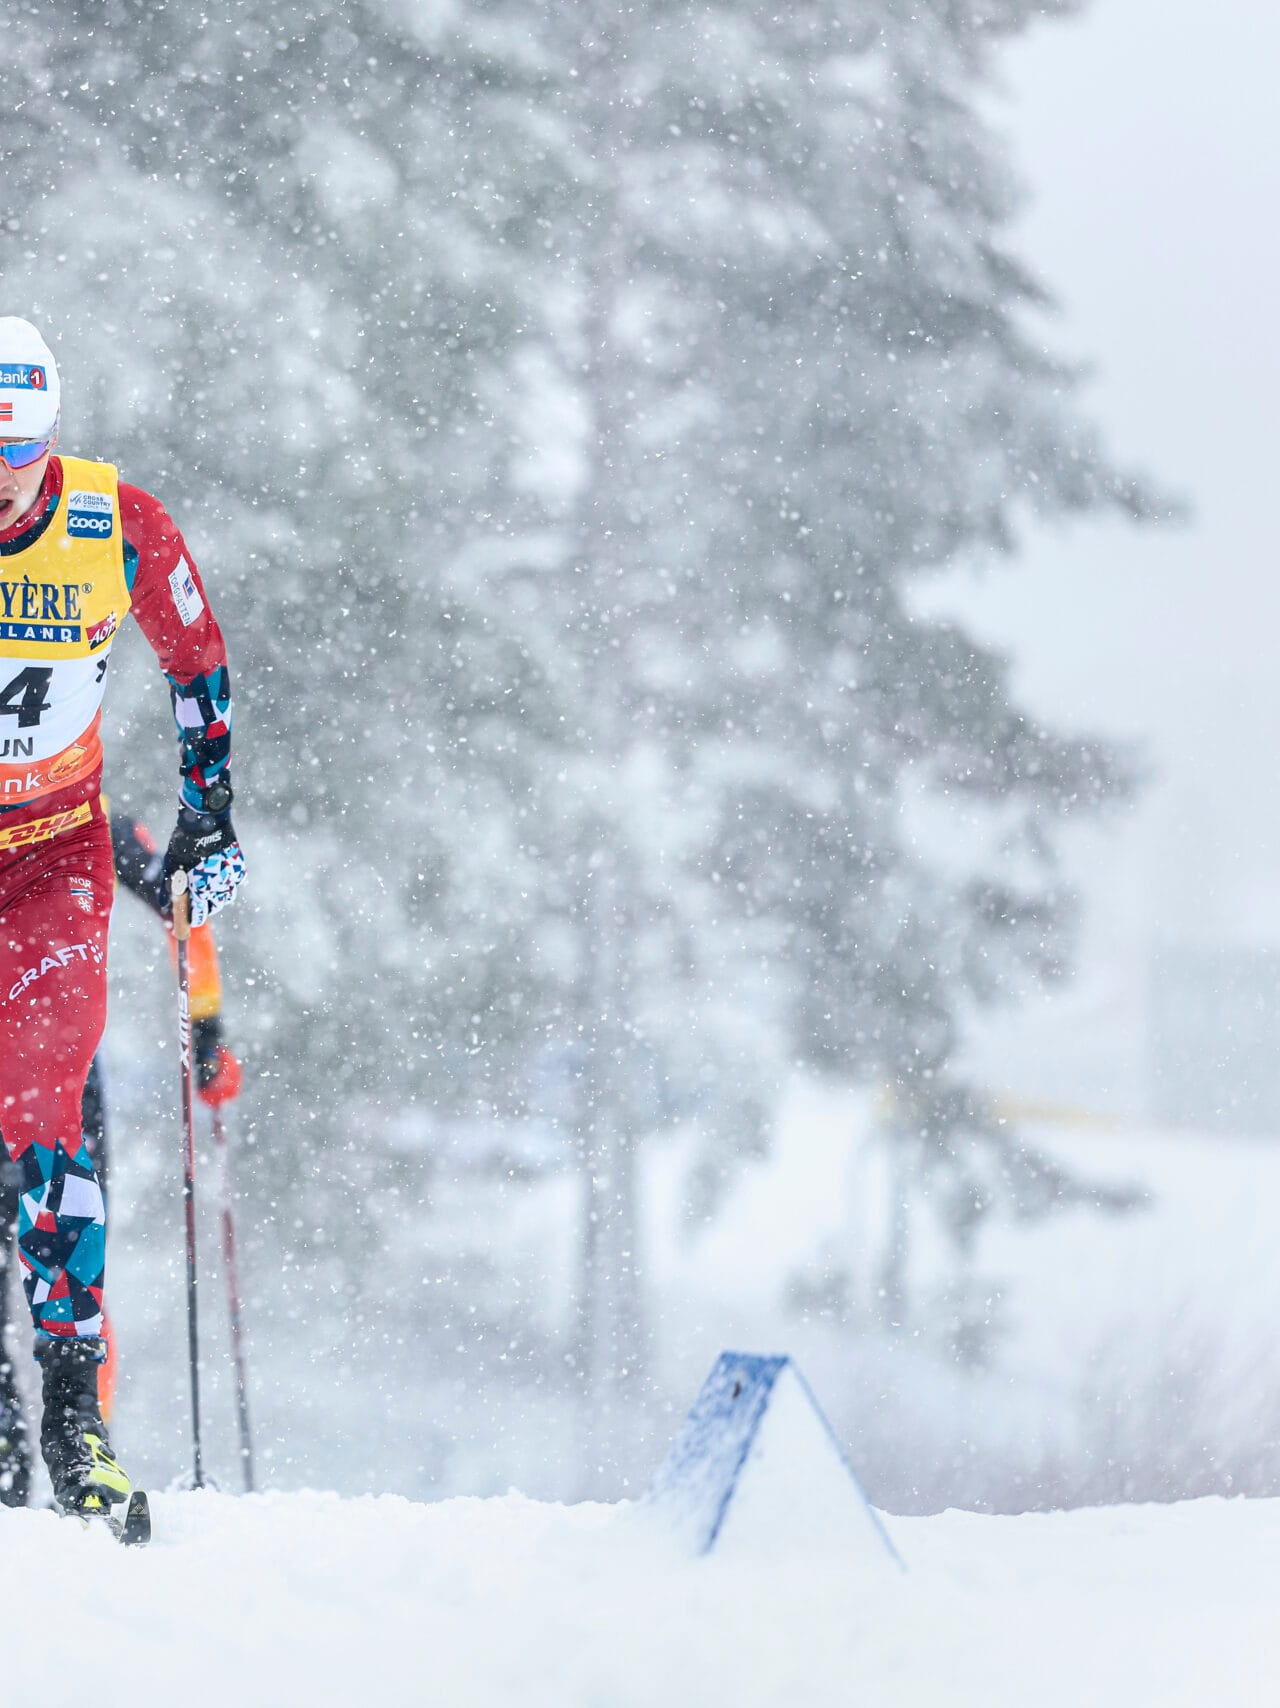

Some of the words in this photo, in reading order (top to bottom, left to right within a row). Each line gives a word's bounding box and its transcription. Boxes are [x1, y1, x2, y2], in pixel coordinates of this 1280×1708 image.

[69, 516, 111, 532] coop
[8, 811, 80, 845] DHL
[69, 877, 92, 888] NOR
[8, 943, 88, 1001] CRAFT
